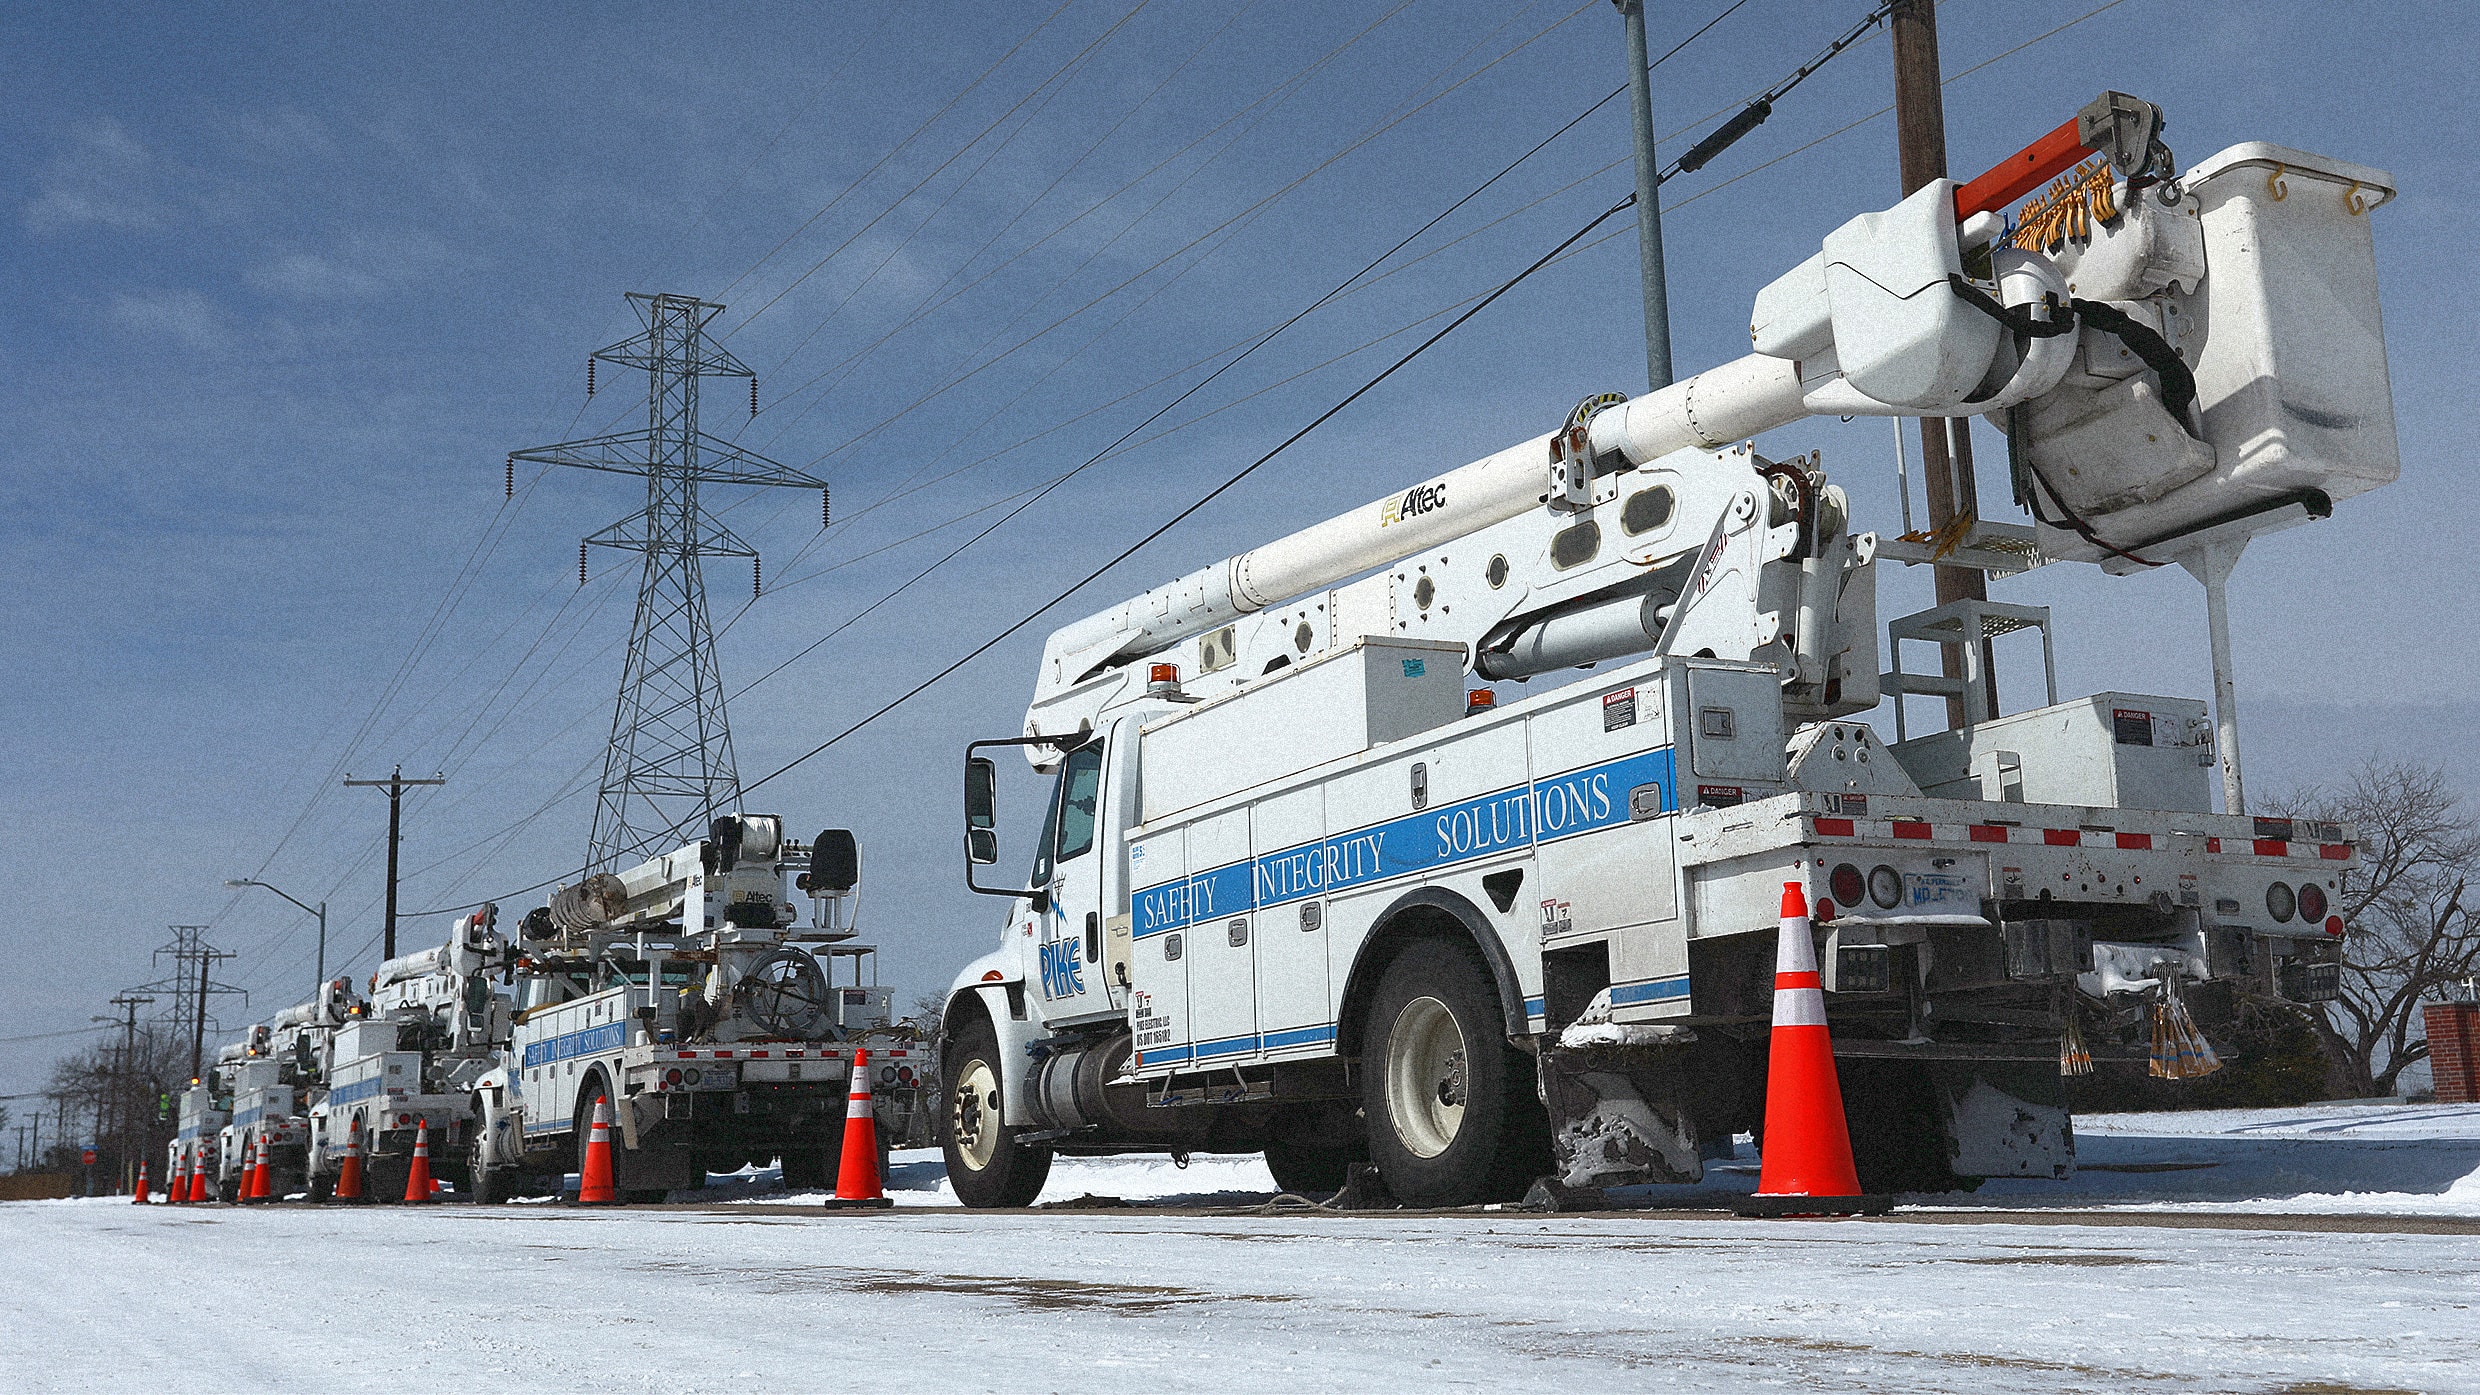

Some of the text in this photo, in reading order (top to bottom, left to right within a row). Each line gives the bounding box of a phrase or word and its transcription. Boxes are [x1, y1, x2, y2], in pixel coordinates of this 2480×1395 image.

[1401, 483, 1446, 521] Altec
[1611, 690, 1632, 702] DANGER
[2123, 711, 2146, 719] DANGER
[1710, 787, 1737, 796] DANGER
[1144, 772, 1611, 930] SAFETY INTEGRITY SOLUTIONS
[746, 891, 773, 903] Altec
[1038, 936, 1086, 1002] PIKE
